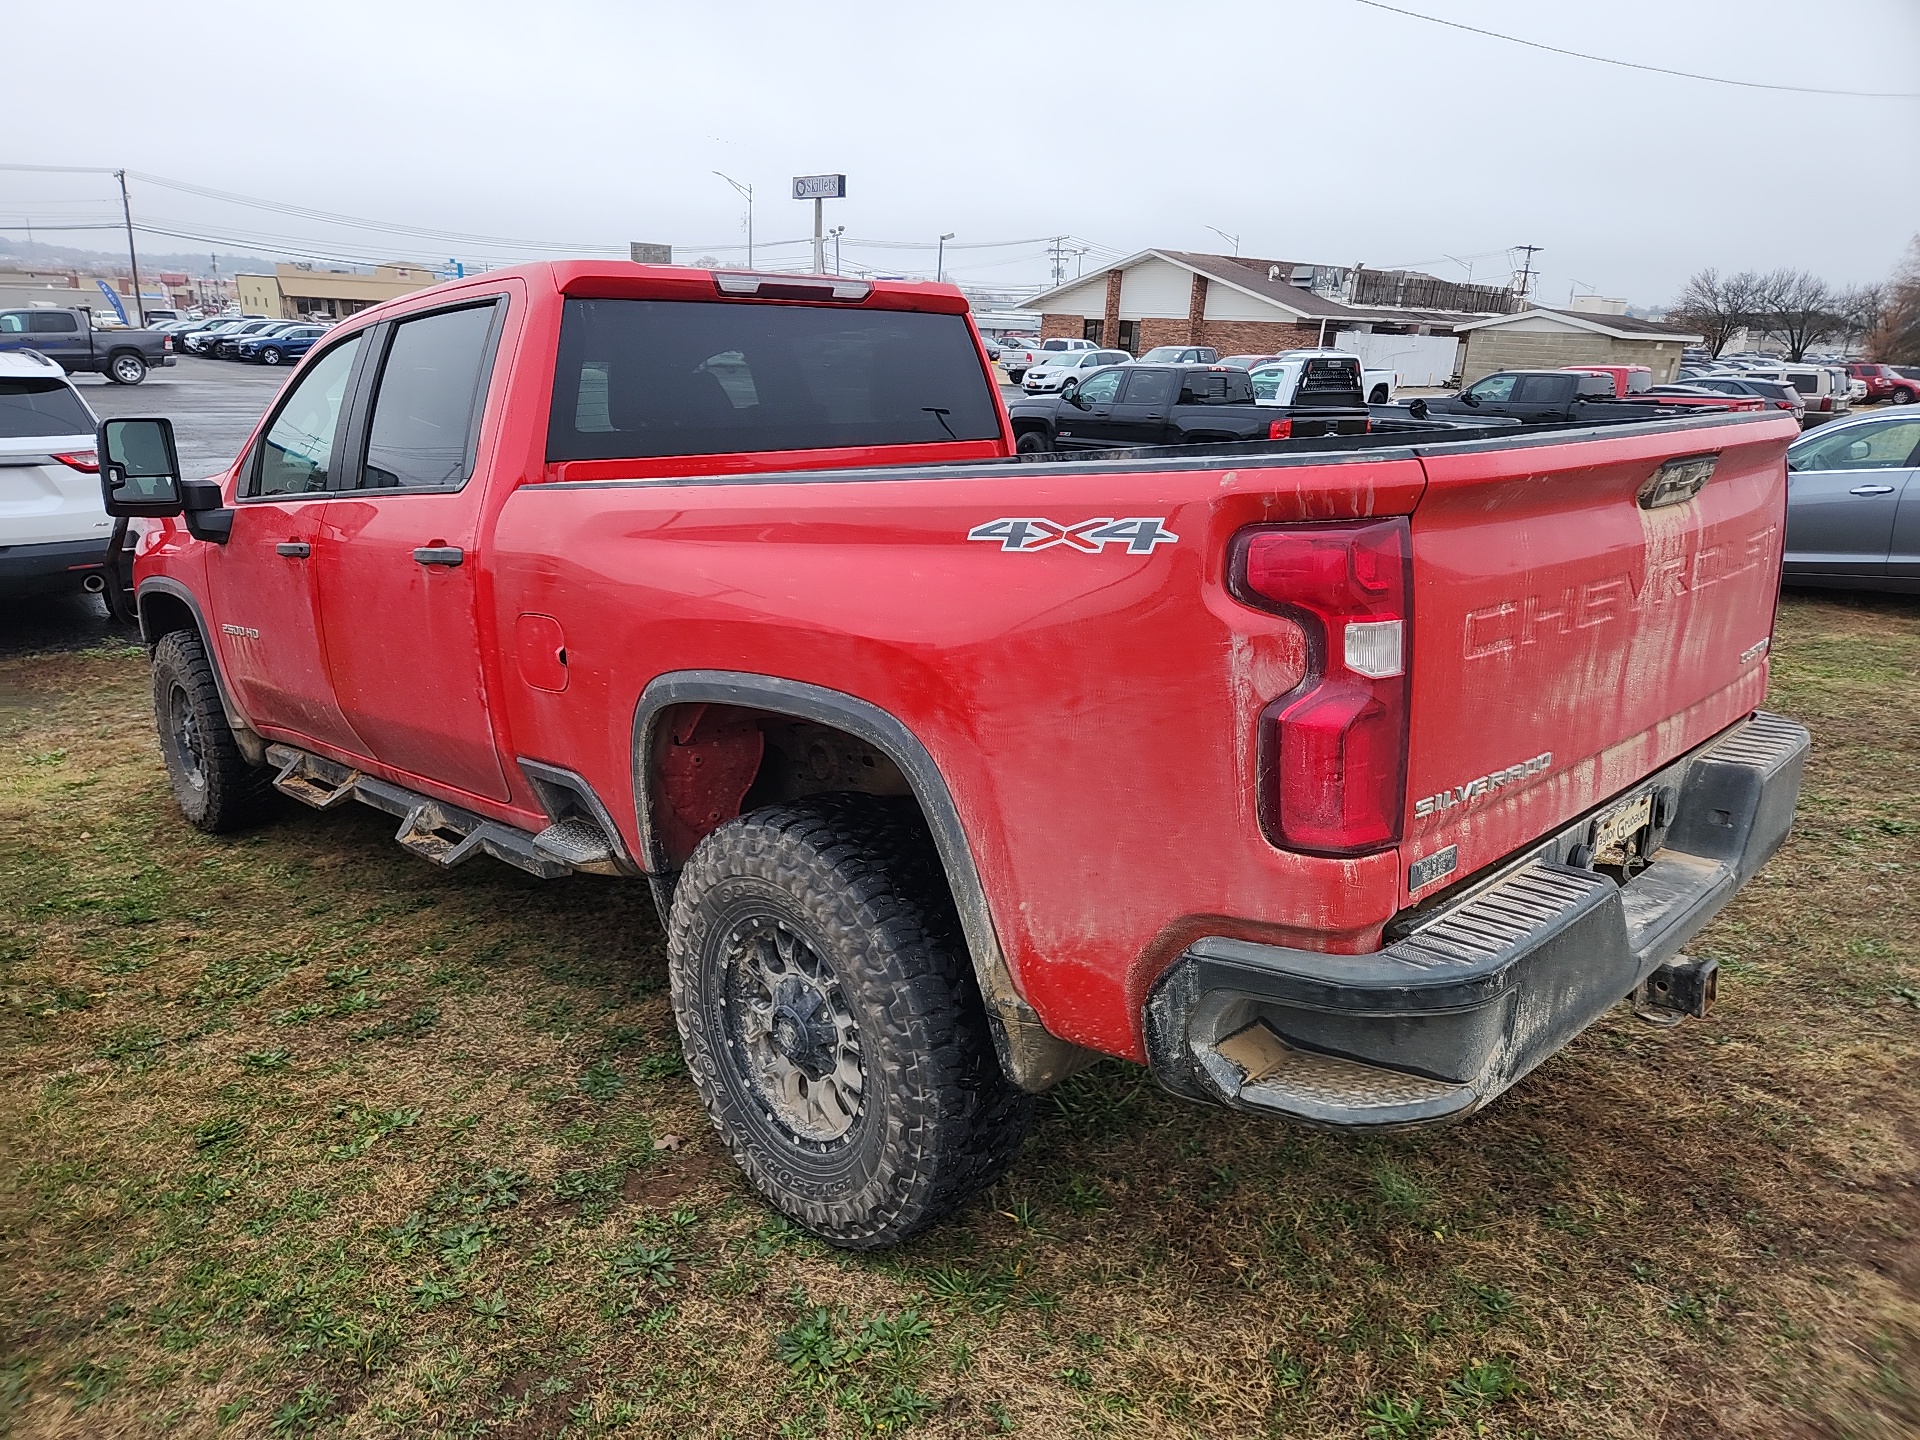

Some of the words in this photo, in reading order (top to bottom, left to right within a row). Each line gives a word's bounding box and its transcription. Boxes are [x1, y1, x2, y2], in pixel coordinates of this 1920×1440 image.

[806, 178, 836, 193] Skillets
[1464, 522, 1776, 660] CHEVROLET
[246, 627, 259, 639] HD
[1414, 751, 1553, 820] SILVERADO
[686, 911, 708, 1004] TIRES
[689, 1010, 727, 1097] TOYO
